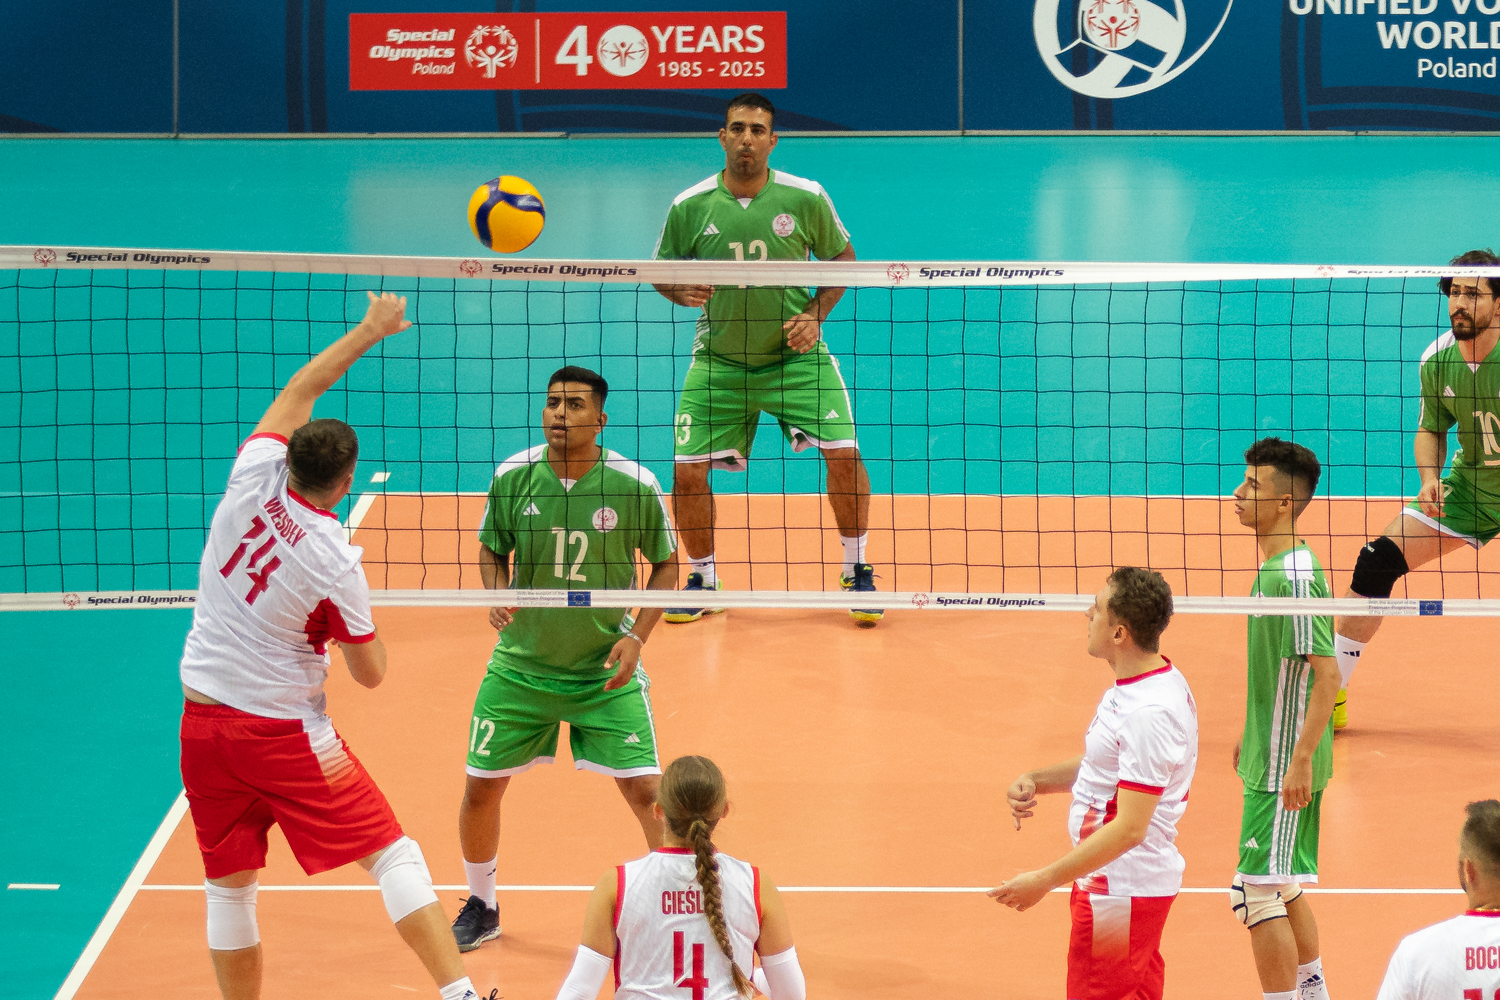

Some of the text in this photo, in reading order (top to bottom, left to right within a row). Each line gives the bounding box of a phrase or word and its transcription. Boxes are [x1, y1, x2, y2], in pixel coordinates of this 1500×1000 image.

[1289, 0, 1438, 15] UNIFIED
[387, 28, 455, 44] Special
[651, 25, 765, 54] YEARS
[369, 45, 455, 60] Olympics
[412, 61, 455, 75] Poland
[659, 62, 702, 77] 1985
[720, 61, 765, 77] 2025
[1417, 56, 1497, 78] Poland
[66, 252, 211, 266] Special Olympics
[490, 264, 638, 278] Special Olympics
[919, 266, 1065, 279] Special Olympics
[263, 496, 307, 548] WESOŁY
[219, 514, 283, 606] 14
[551, 527, 589, 582] 12
[87, 594, 196, 606] Special Olympics
[936, 596, 1046, 608] Special Olympics
[469, 715, 496, 756] 12
[661, 886, 705, 915] CIEŚL
